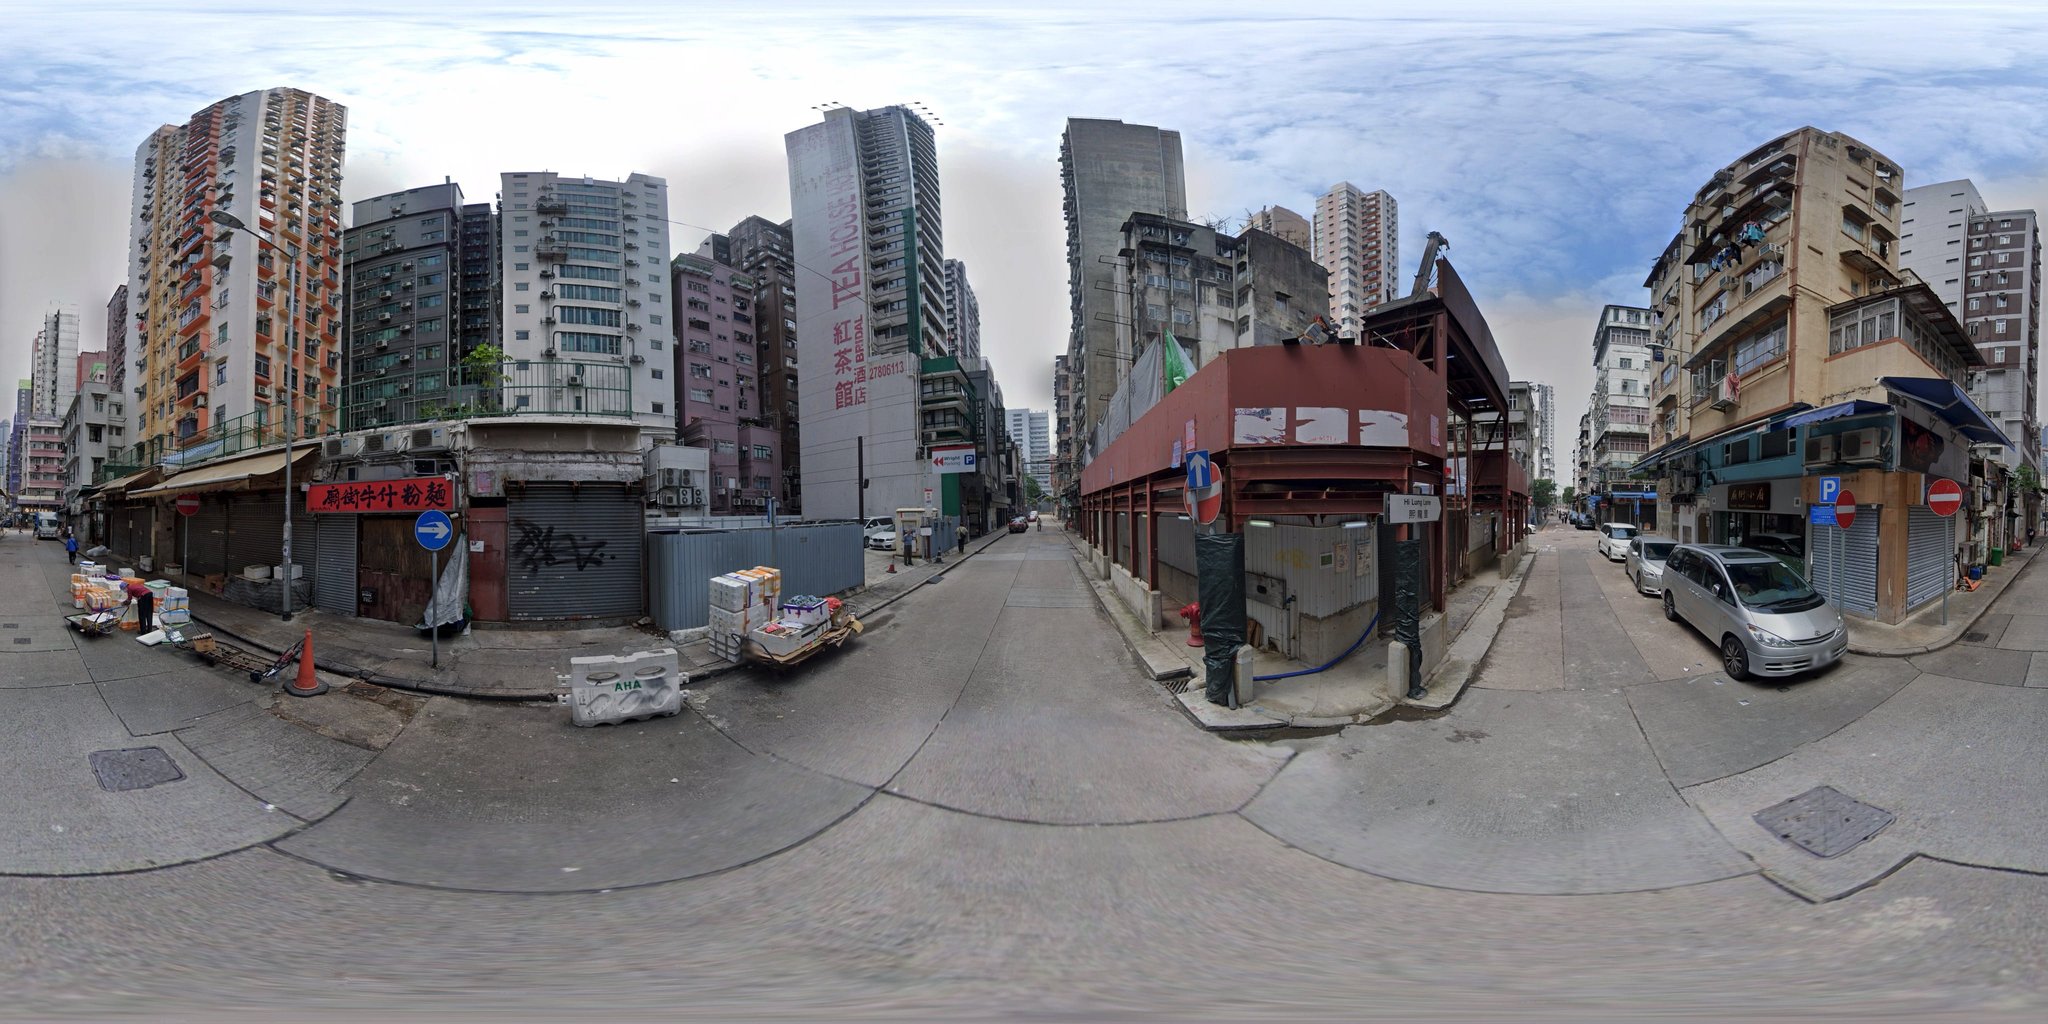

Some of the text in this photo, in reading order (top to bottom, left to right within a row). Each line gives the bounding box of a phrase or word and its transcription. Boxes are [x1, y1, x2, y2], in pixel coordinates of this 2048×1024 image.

[828, 193, 859, 258] HOUSE
[832, 255, 861, 310] TEA
[854, 314, 865, 363] BRIDAL
[833, 320, 853, 409] 紅茶館
[869, 361, 904, 380] 27806113
[854, 366, 867, 405] 酒店
[966, 456, 973, 464] P
[323, 481, 447, 510] 廟街牛什粉麵
[1823, 480, 1837, 500] P
[614, 680, 642, 692] AHA
